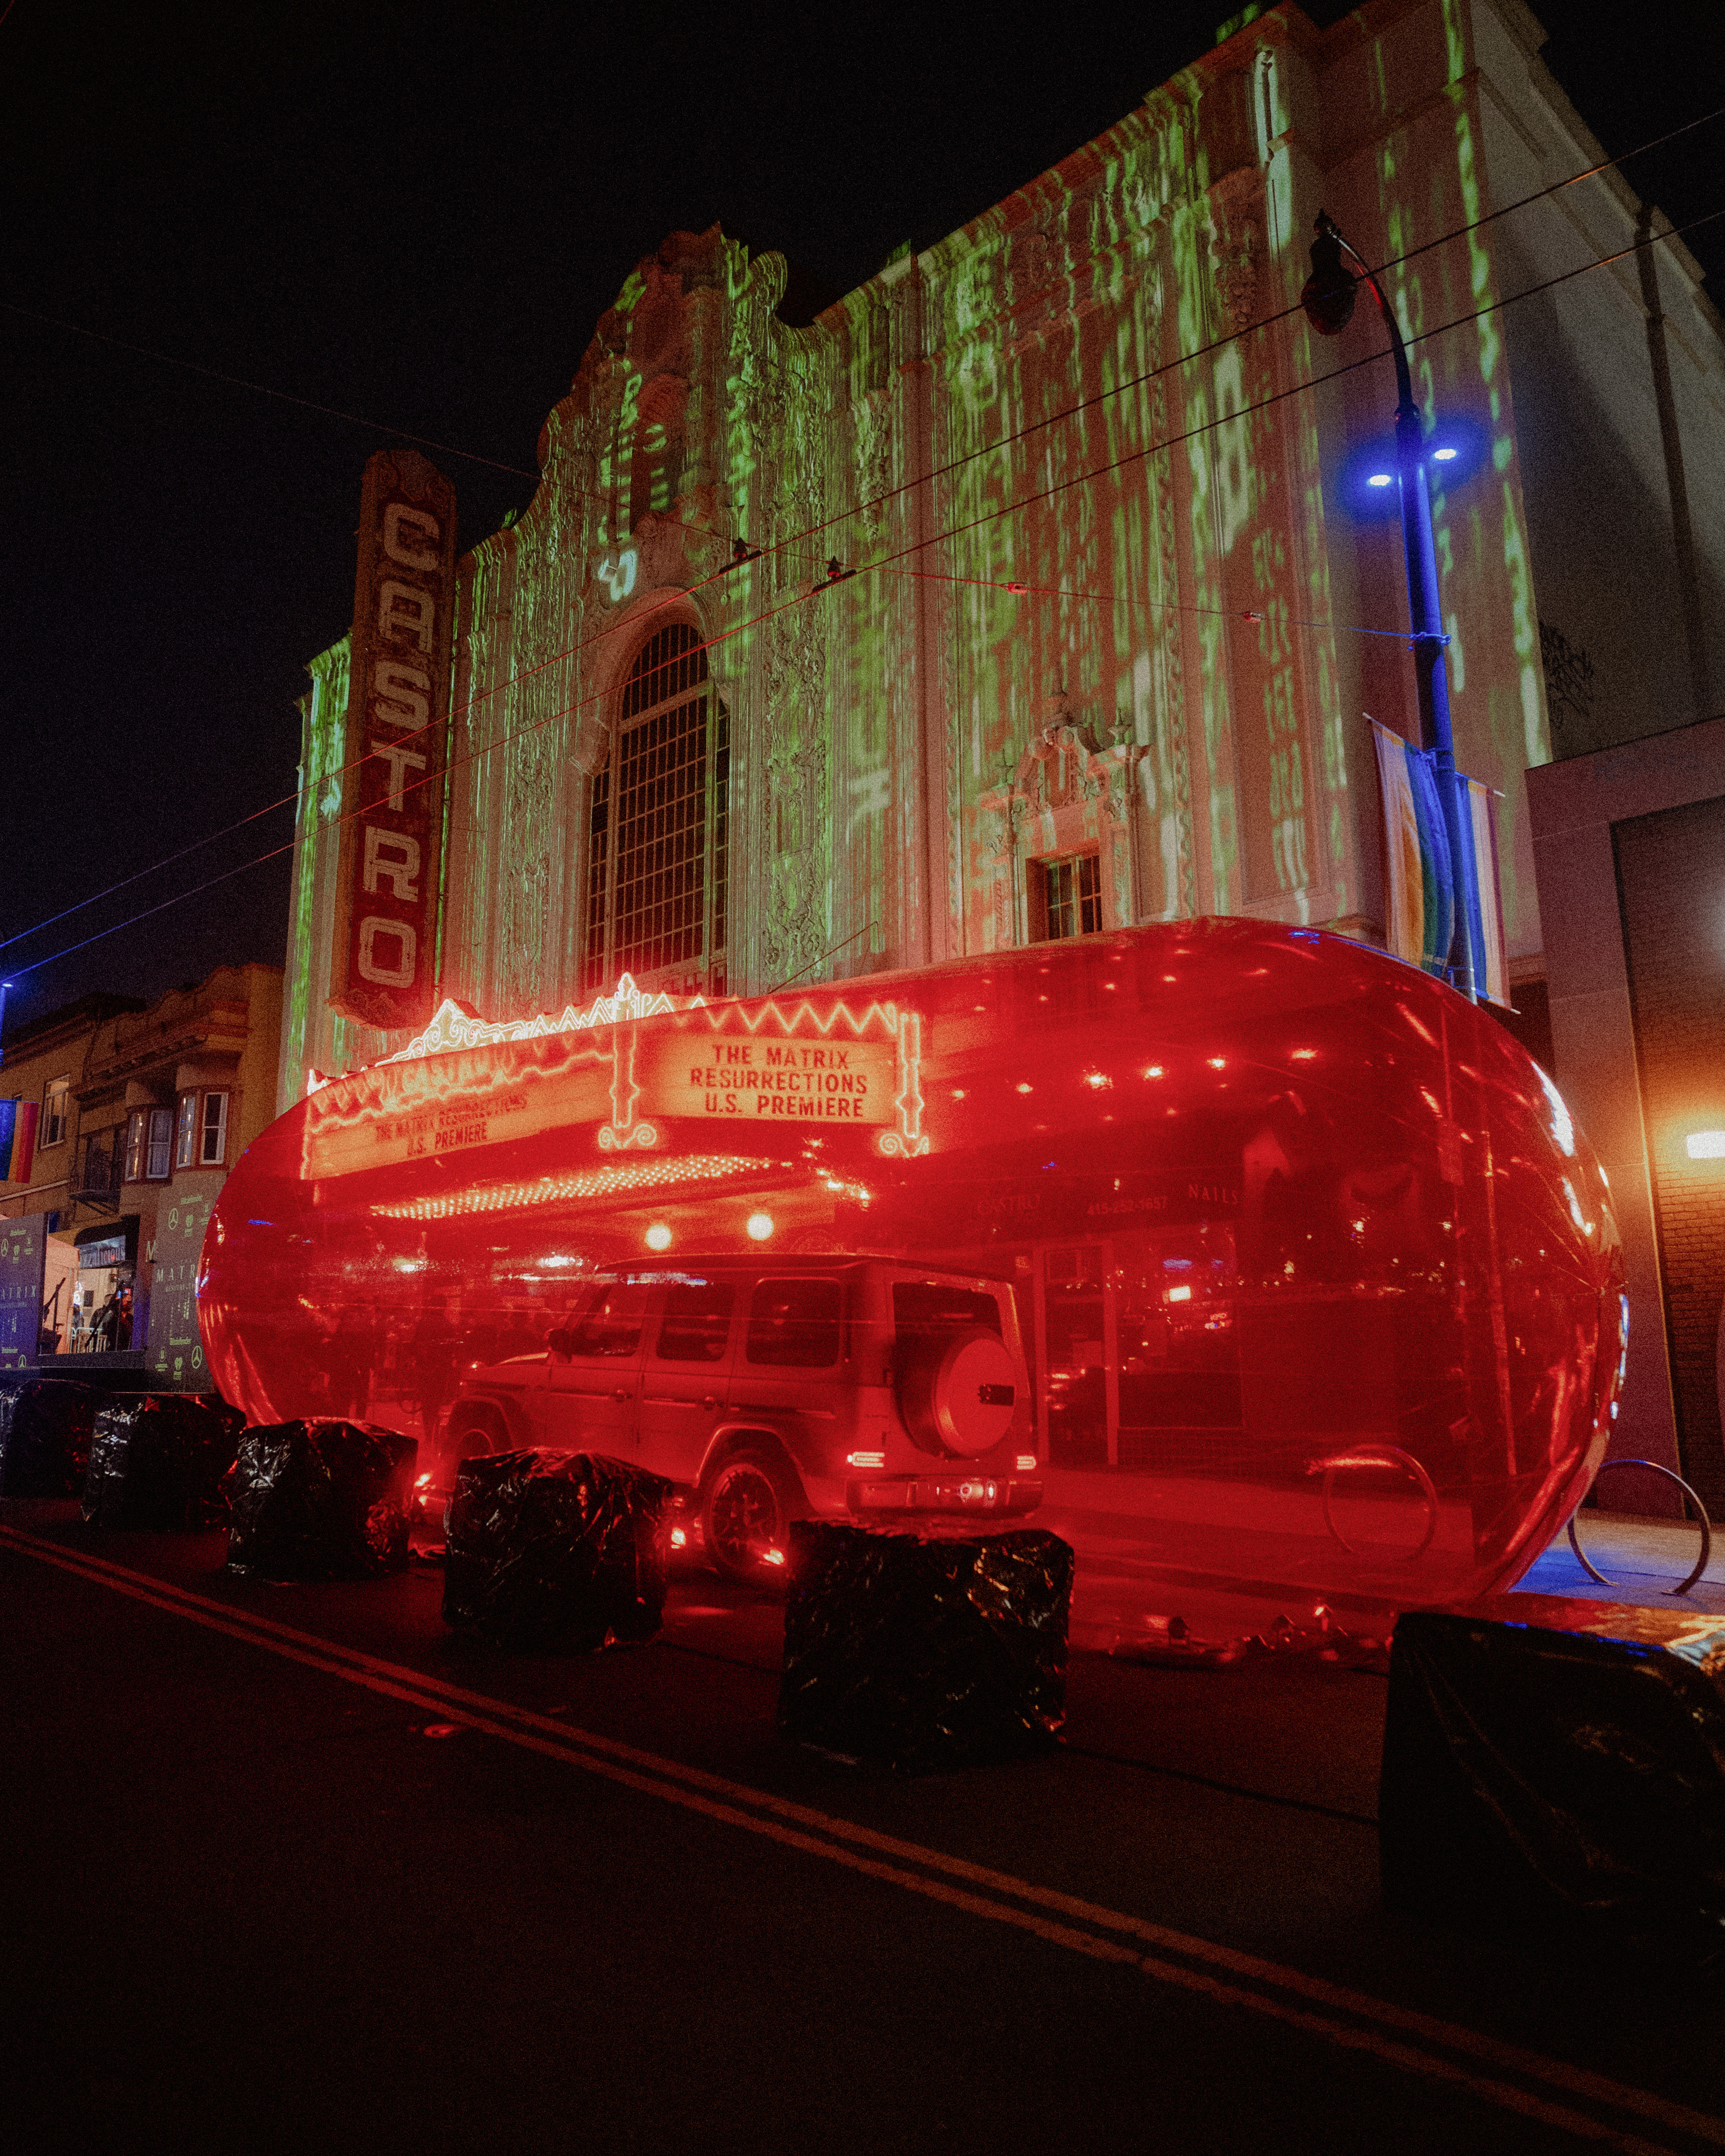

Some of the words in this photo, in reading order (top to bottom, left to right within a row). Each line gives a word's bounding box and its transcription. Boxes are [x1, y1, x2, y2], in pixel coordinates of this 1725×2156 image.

[358, 501, 440, 989] CASTRO
[711, 1044, 752, 1065] THE
[765, 1046, 849, 1071] MATRIX
[690, 1068, 868, 1094] RESURRECTIONS
[704, 1094, 743, 1114] U.S.
[757, 1095, 864, 1118] PREMIERE
[434, 1121, 488, 1149] PREMIERE
[1188, 1183, 1239, 1205] NAILS
[156, 1264, 195, 1284] MATR
[1, 1285, 36, 1300] ATRIX
